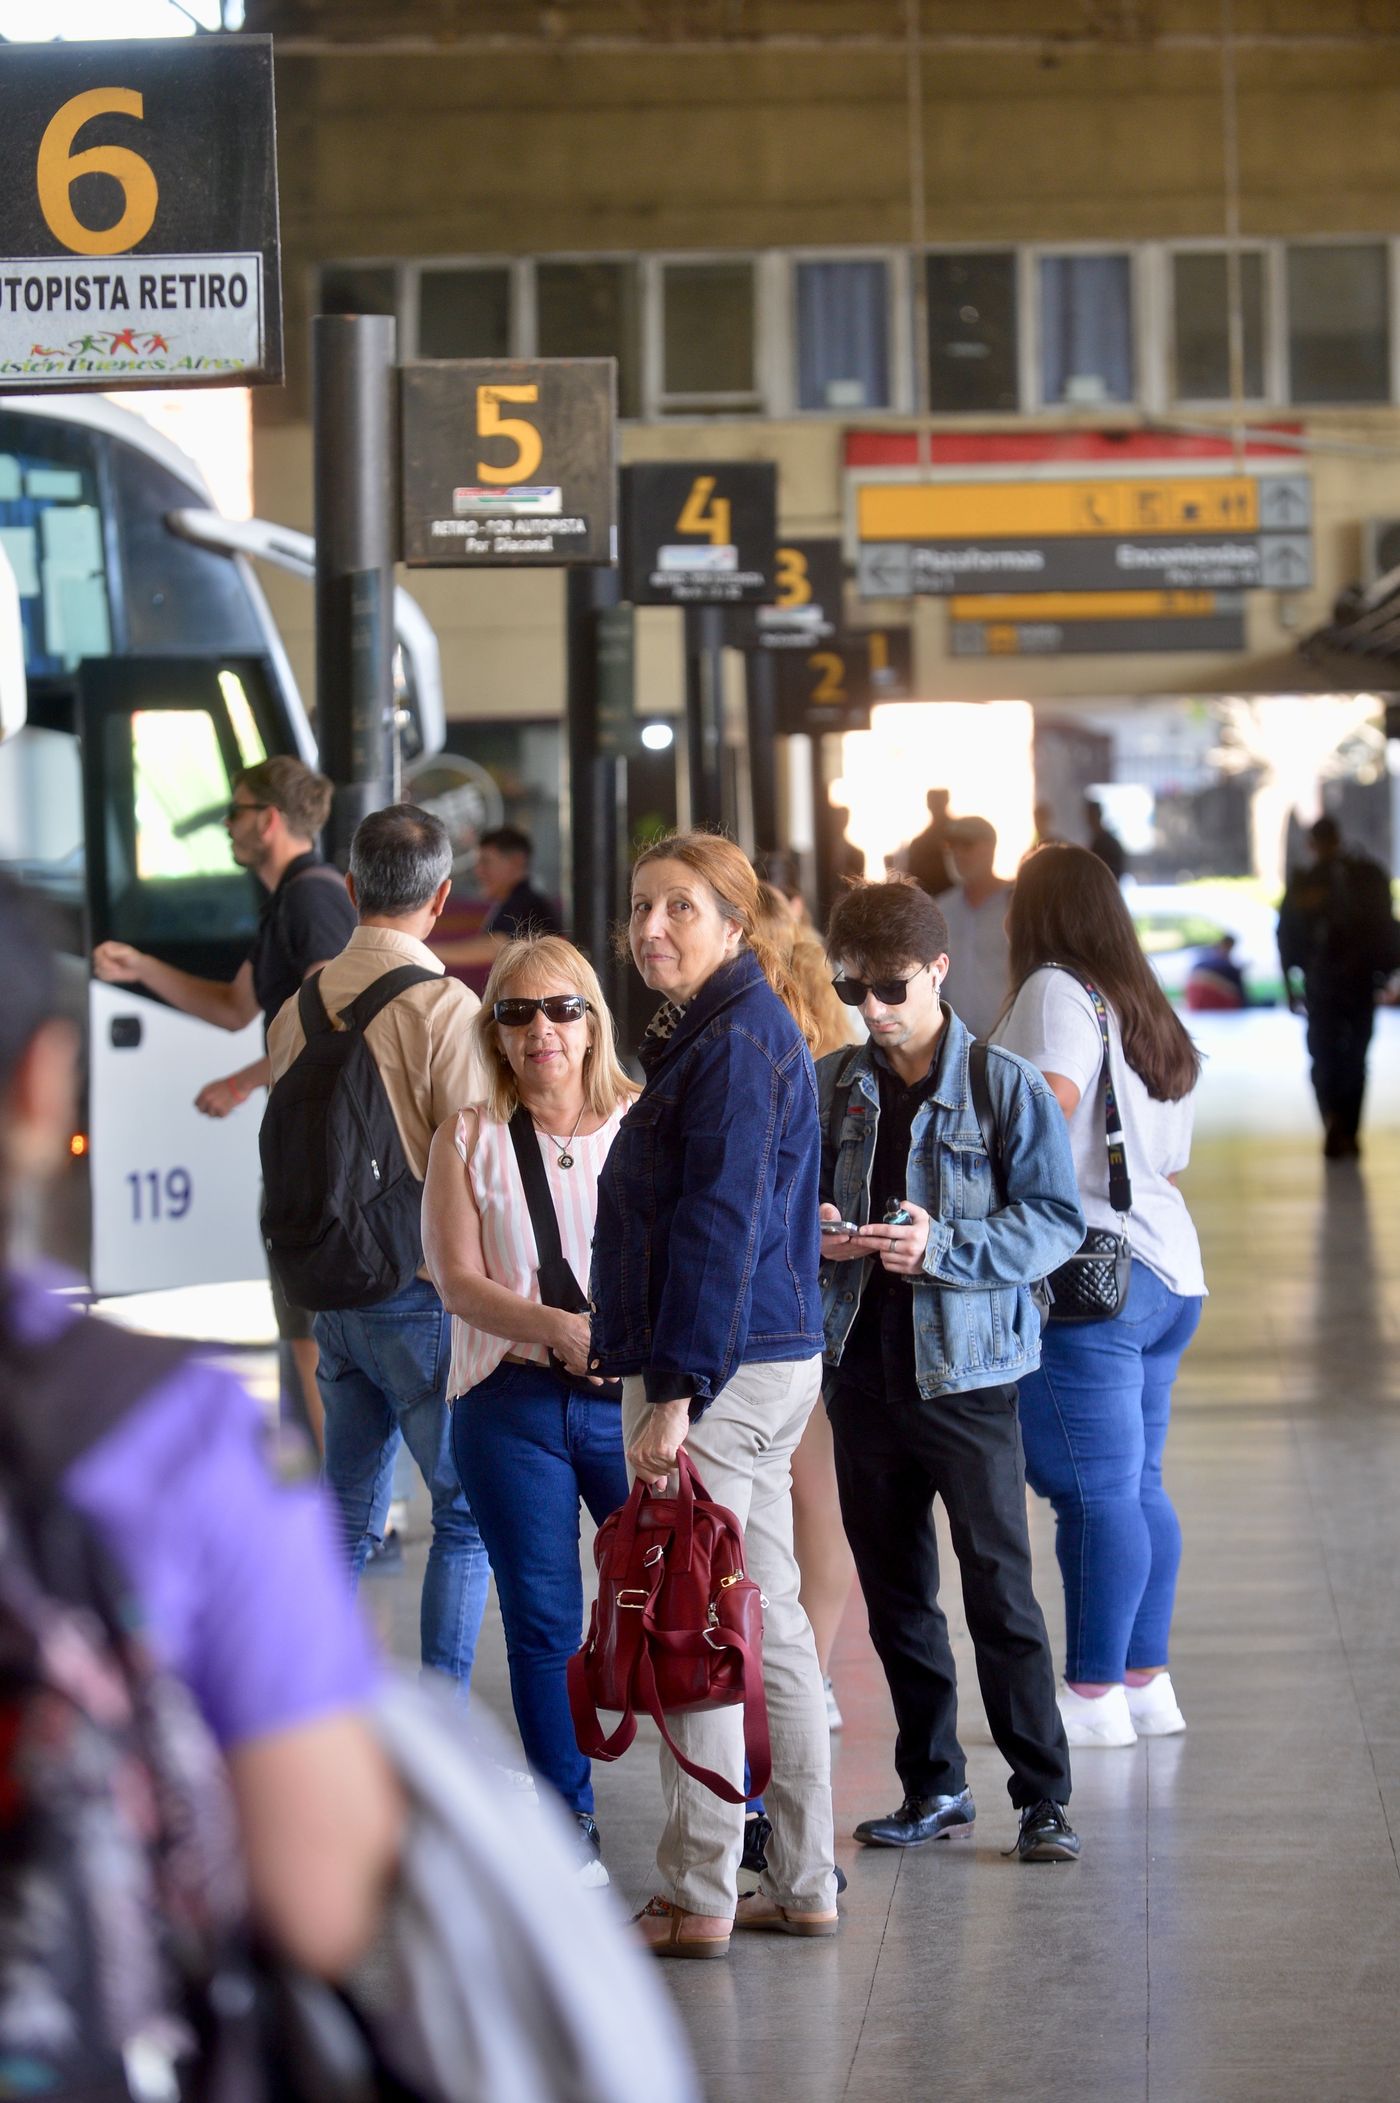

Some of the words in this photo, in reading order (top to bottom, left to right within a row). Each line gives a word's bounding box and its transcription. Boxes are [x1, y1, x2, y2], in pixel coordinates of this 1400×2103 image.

[37, 86, 158, 255] 6
[0, 275, 130, 312] TOPISTA
[140, 272, 248, 309] RETIRO
[67, 355, 166, 373] Buenos
[170, 354, 245, 371] Aires
[476, 384, 543, 484] 5
[431, 519, 479, 537] RETIRO
[675, 475, 731, 545] 4
[775, 548, 812, 607] 3
[808, 652, 848, 704] 2
[127, 1167, 193, 1224] 119
